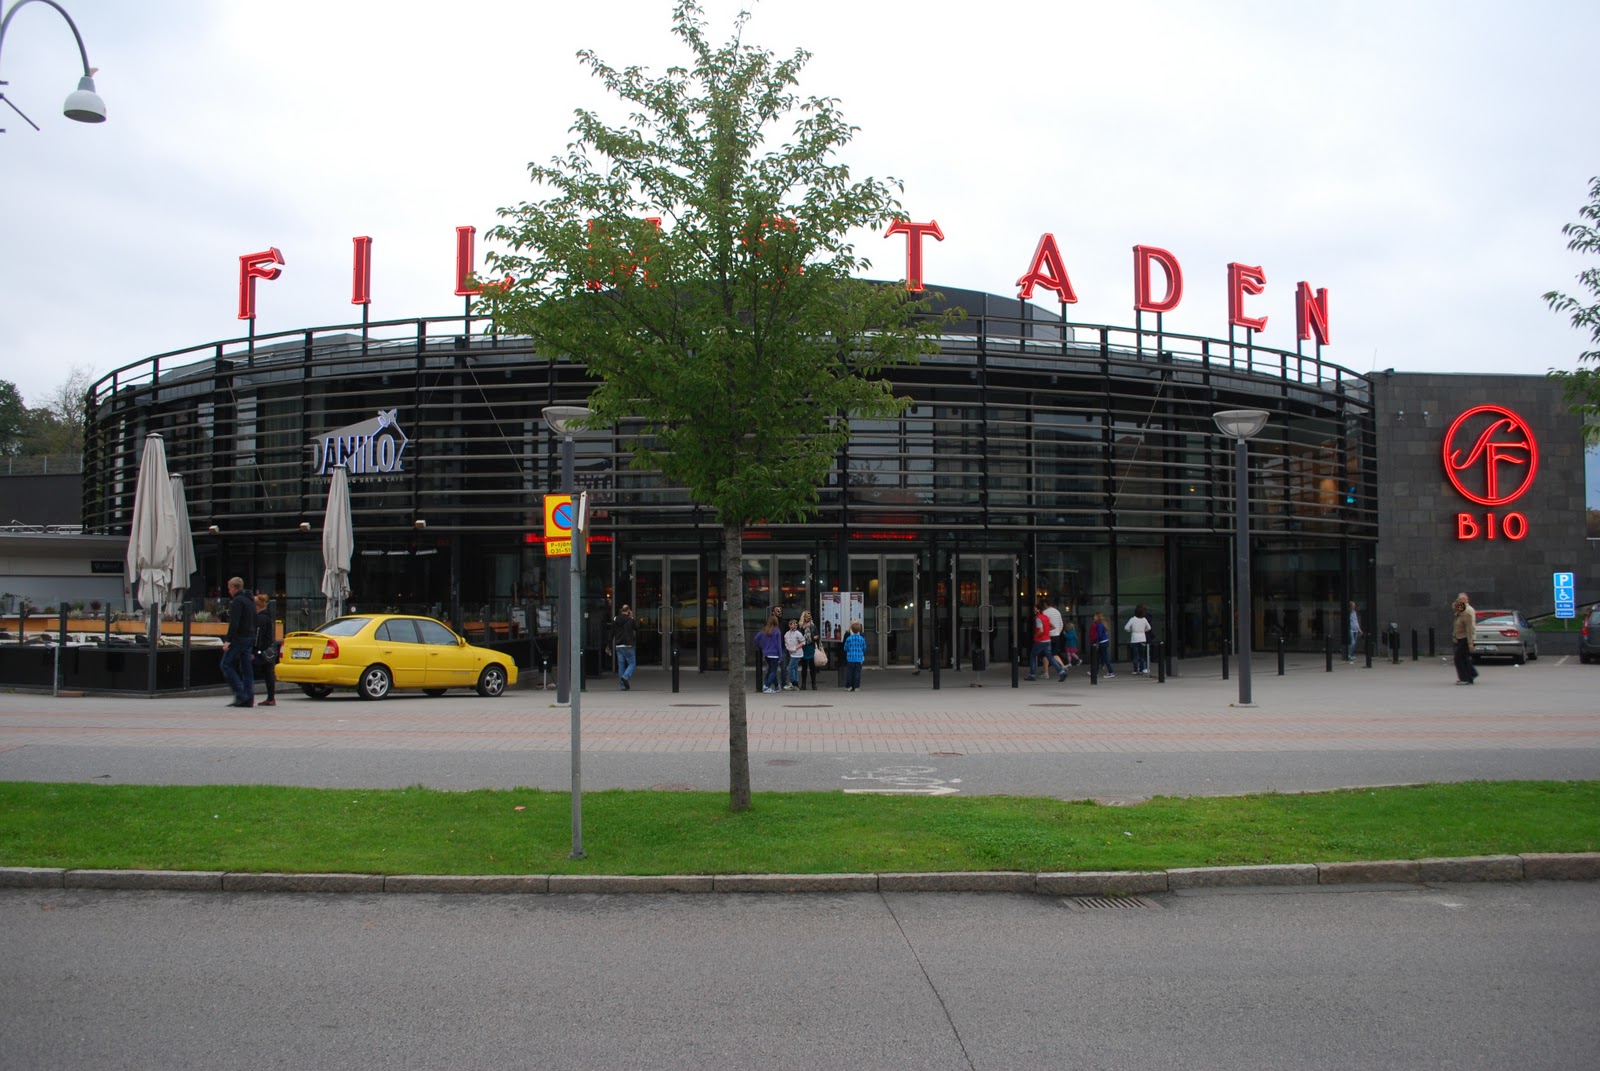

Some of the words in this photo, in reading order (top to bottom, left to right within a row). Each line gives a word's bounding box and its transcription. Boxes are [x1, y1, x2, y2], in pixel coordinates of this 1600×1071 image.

[237, 216, 1330, 346] FILTADEN
[1457, 511, 1529, 541] BIO
[1560, 574, 1569, 587] P
